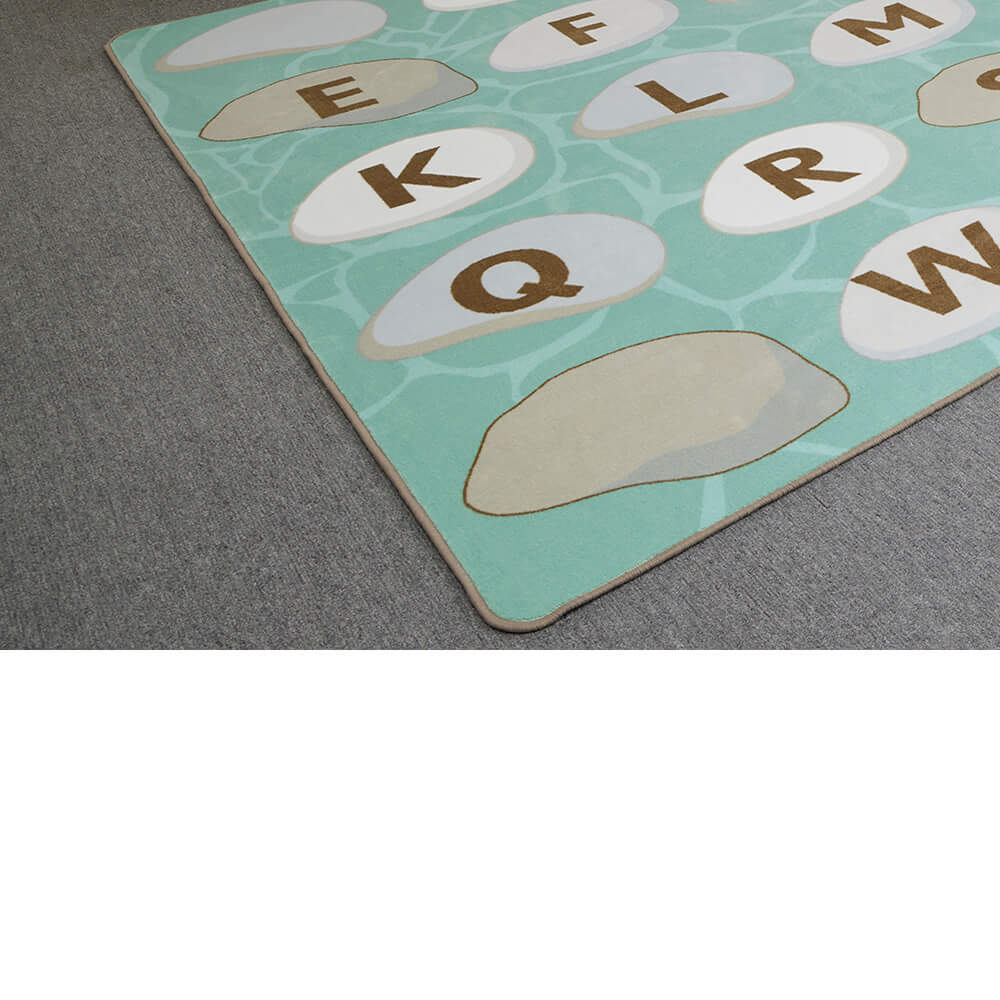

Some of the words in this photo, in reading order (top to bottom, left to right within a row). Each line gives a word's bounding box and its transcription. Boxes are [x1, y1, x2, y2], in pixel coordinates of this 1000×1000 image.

[548, 12, 607, 46] F
[831, 2, 943, 47] M
[295, 76, 380, 119] E
[636, 81, 729, 115] L
[359, 146, 480, 209] K
[744, 147, 861, 201] R
[450, 249, 585, 315] Q
